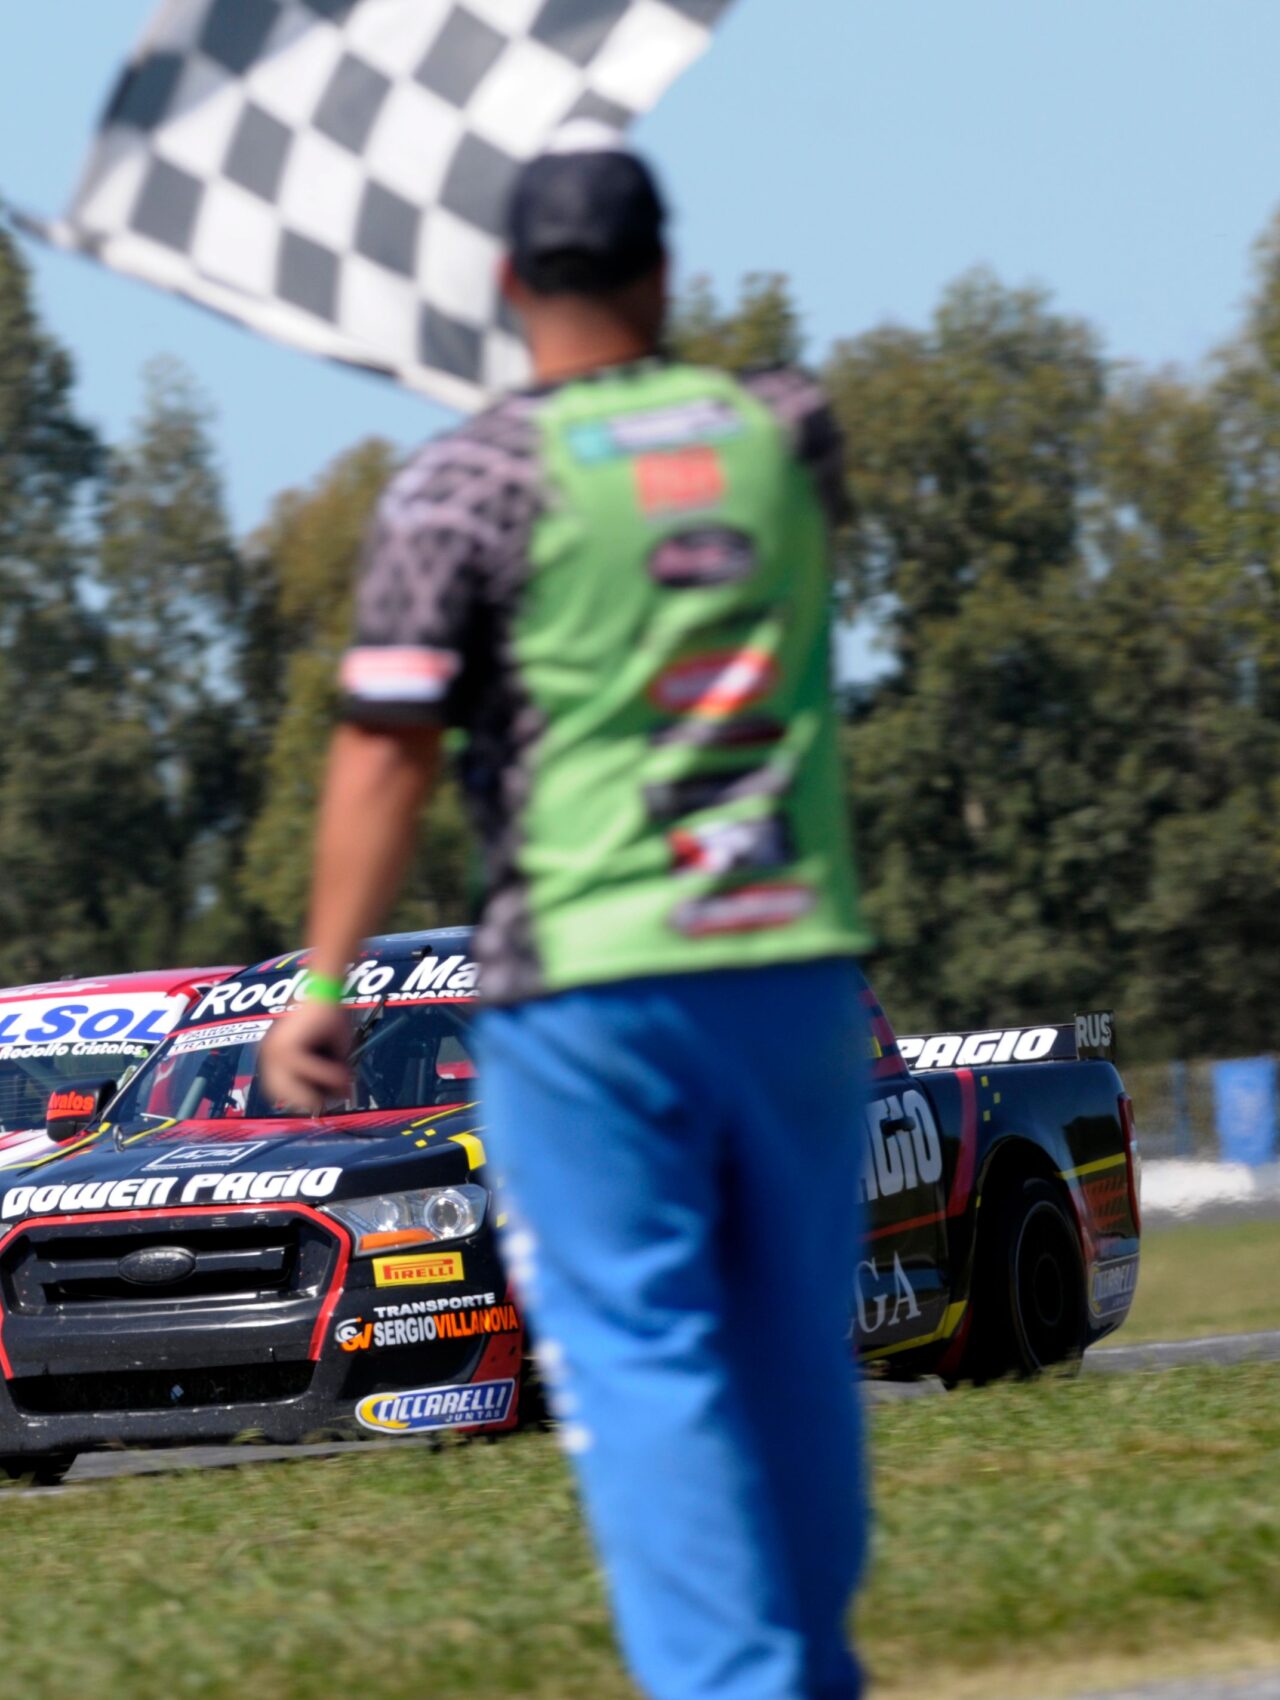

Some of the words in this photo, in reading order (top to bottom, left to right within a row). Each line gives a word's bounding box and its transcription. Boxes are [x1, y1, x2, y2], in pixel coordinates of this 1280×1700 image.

[189, 960, 395, 1020] Rodfo
[1075, 1013, 1111, 1048] RUS
[71, 1041, 142, 1058] Cristales
[858, 1089, 943, 1203] GIO
[181, 1167, 343, 1203] PAGIO
[382, 1258, 454, 1281] PIRELLI
[373, 1292, 495, 1319] TRANSPORTE
[377, 1385, 507, 1422] CICCARELLI
[446, 1408, 500, 1423] JUNTAS
